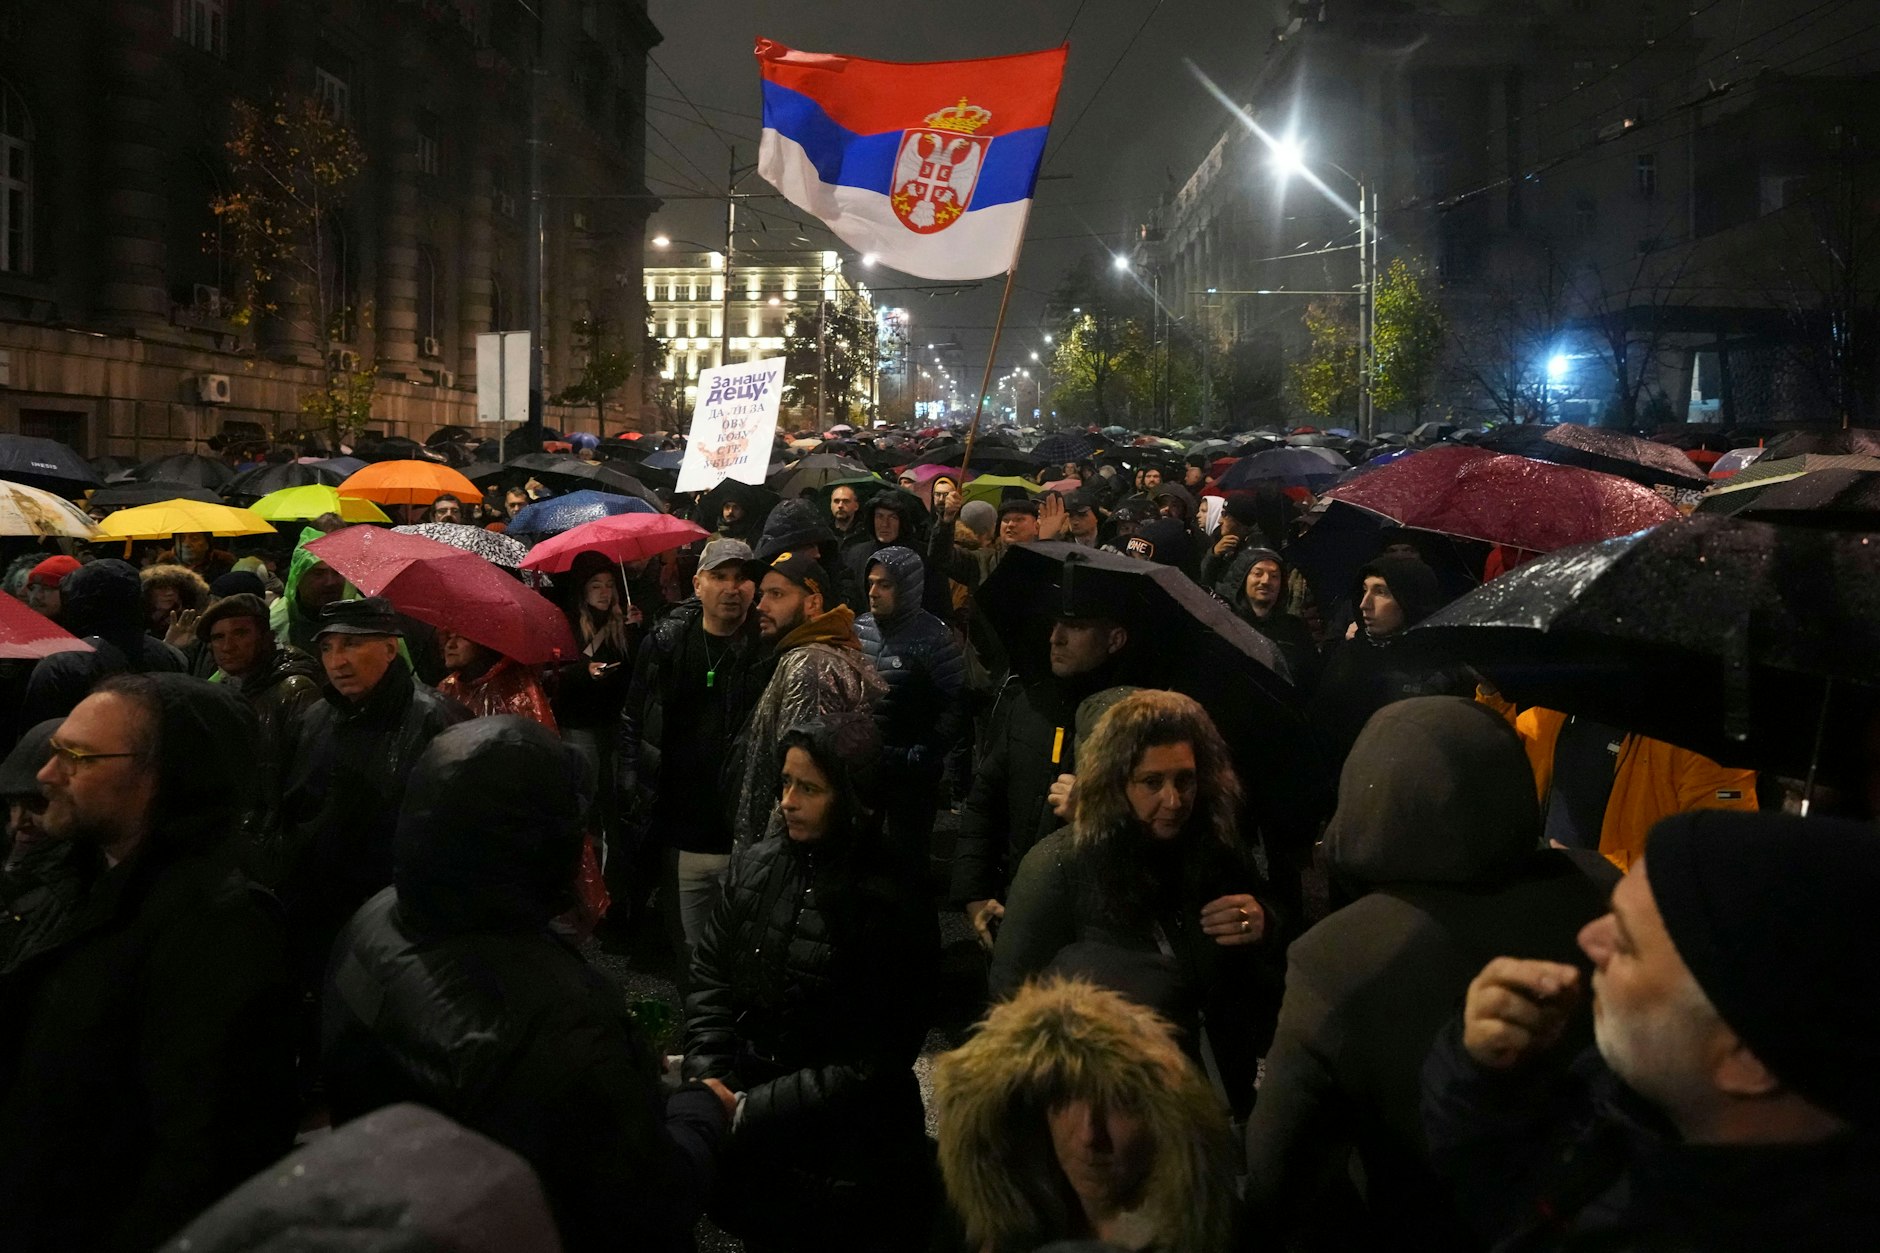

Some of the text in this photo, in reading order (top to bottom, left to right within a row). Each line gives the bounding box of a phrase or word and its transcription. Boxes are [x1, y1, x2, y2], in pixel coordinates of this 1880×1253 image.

[711, 371, 777, 389] За нашу
[706, 382, 768, 406] децу.
[709, 409, 724, 419] ДА
[750, 403, 765, 413] ЗА
[722, 417, 748, 429] ОВУ
[717, 444, 742, 455] СТЕ
[704, 456, 748, 468] УБИЛИ
